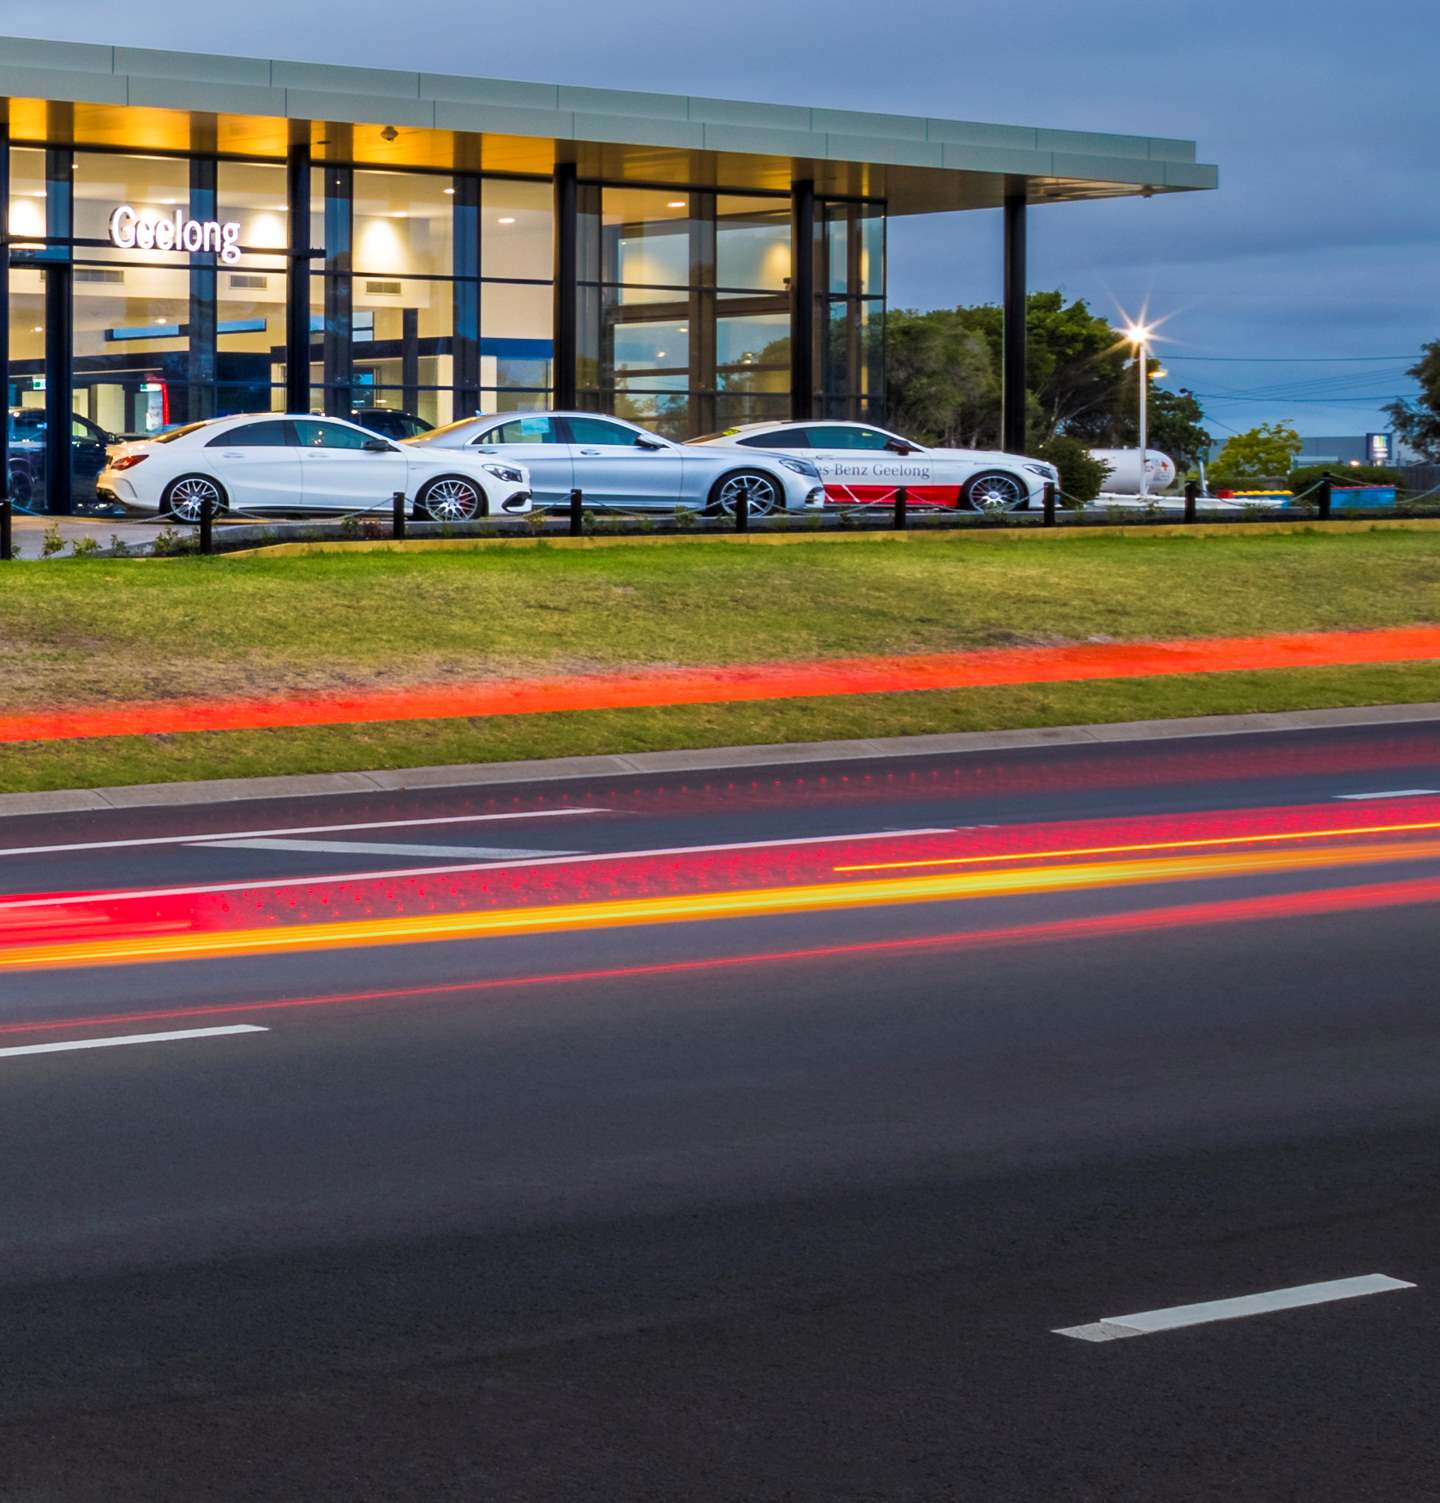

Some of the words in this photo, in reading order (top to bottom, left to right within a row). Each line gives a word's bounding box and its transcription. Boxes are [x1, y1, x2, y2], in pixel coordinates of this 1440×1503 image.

[110, 205, 242, 265] Geelong
[817, 463, 868, 477] es-Benz
[872, 464, 930, 480] Geelong
